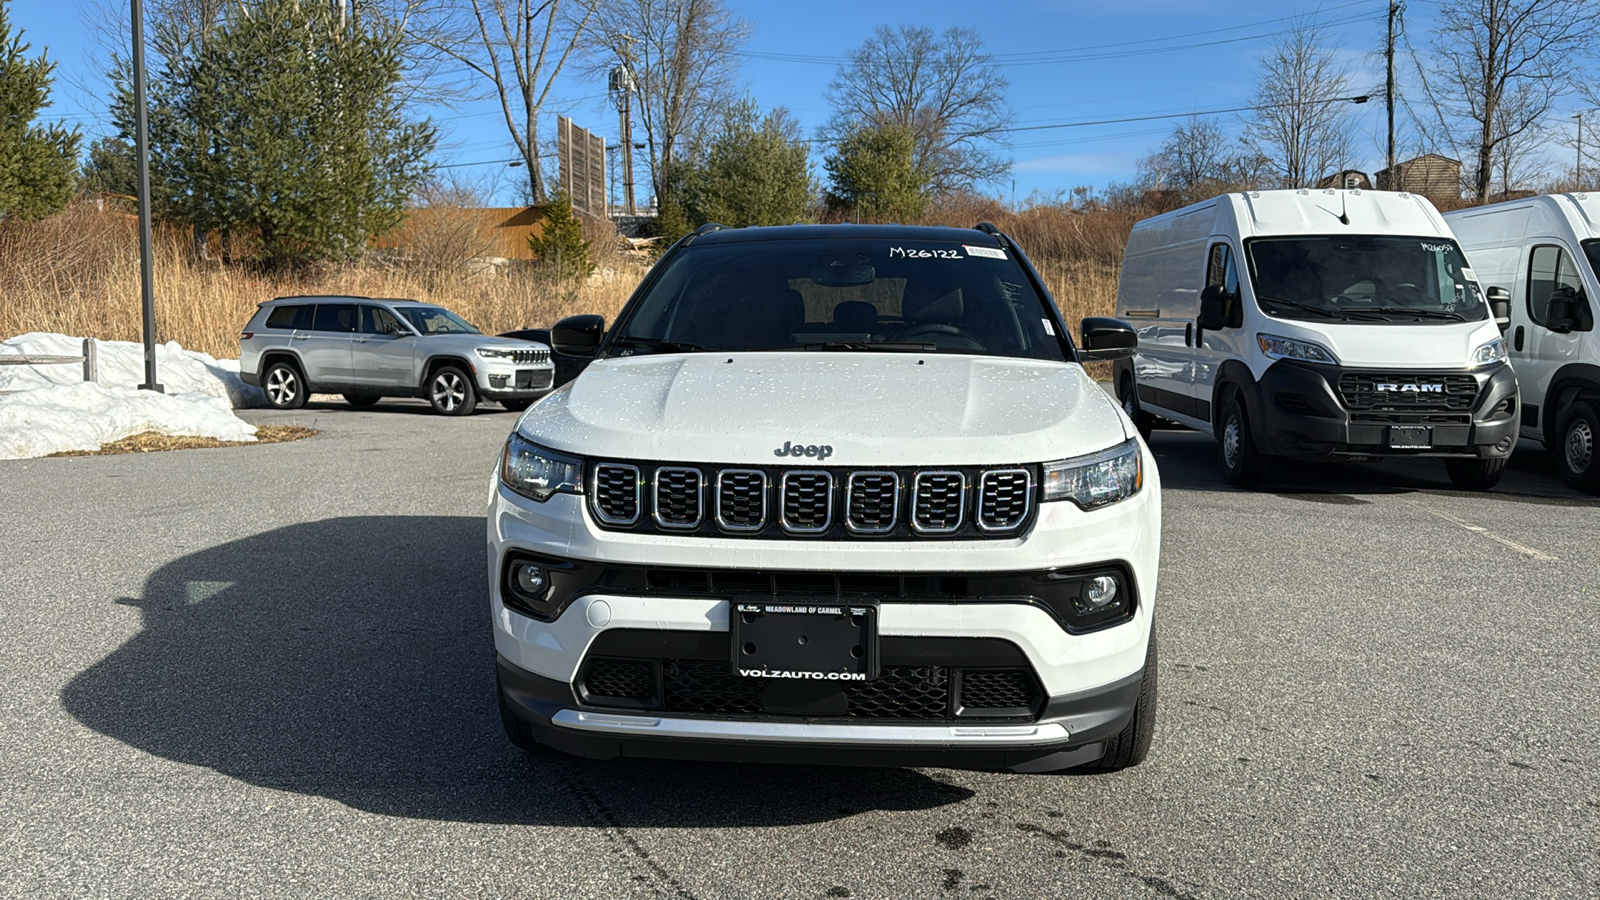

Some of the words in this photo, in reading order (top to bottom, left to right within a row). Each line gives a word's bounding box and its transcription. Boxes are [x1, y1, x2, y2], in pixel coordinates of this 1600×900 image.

[889, 246, 964, 259] M26122
[1376, 383, 1443, 393] RAM
[773, 440, 833, 461] Jeep
[765, 605, 807, 614] MEADOWLAND
[808, 606, 817, 614] OF
[817, 606, 842, 615] CARMEL
[739, 669, 866, 681] VOLZAUTO.COM
